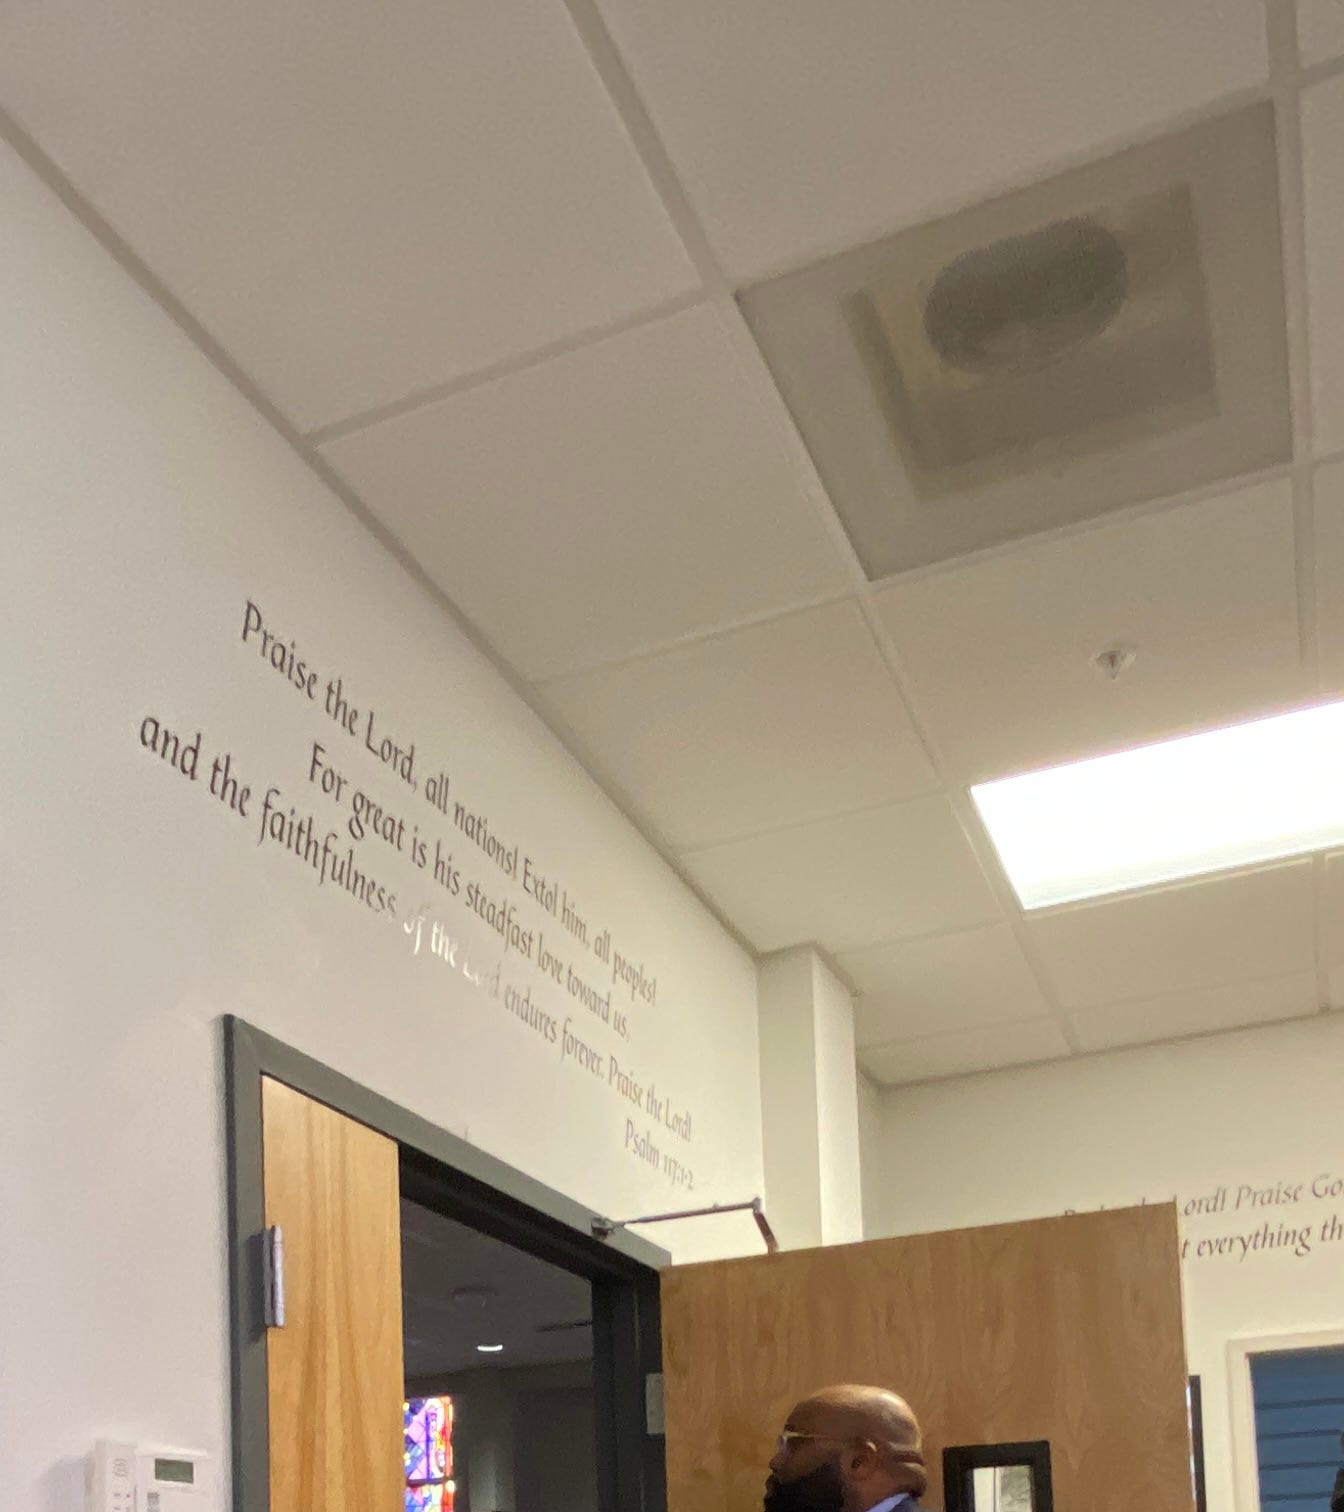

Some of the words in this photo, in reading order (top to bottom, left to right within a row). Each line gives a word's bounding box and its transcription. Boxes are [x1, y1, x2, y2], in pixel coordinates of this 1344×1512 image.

[241, 599, 318, 700] Praise
[324, 677, 359, 737] the
[365, 710, 417, 792] Lord,
[425, 772, 450, 815] all
[454, 801, 518, 882] nations!
[522, 857, 558, 918] Extol
[561, 890, 591, 951] him,
[594, 928, 611, 965] all
[613, 950, 657, 1007] peoples!
[309, 740, 349, 802] For
[348, 791, 405, 852] great
[412, 825, 427, 869] is
[433, 839, 461, 897] his
[465, 883, 534, 960] steadfast
[537, 932, 563, 985] love
[567, 962, 611, 1025] toward
[139, 716, 202, 781] and
[209, 753, 251, 817] the
[257, 788, 397, 915] faithfulness
[431, 920, 459, 968] the
[504, 983, 557, 1044] endures
[560, 1017, 605, 1080] forever.
[608, 1054, 644, 1109] Praise
[646, 1083, 662, 1123] the
[664, 1097, 692, 1143] Lord!
[624, 1117, 660, 1169] Psalm
[1178, 1184, 1229, 1218] ord!
[1235, 1180, 1304, 1211] Praise
[1196, 1221, 1312, 1263] everything
